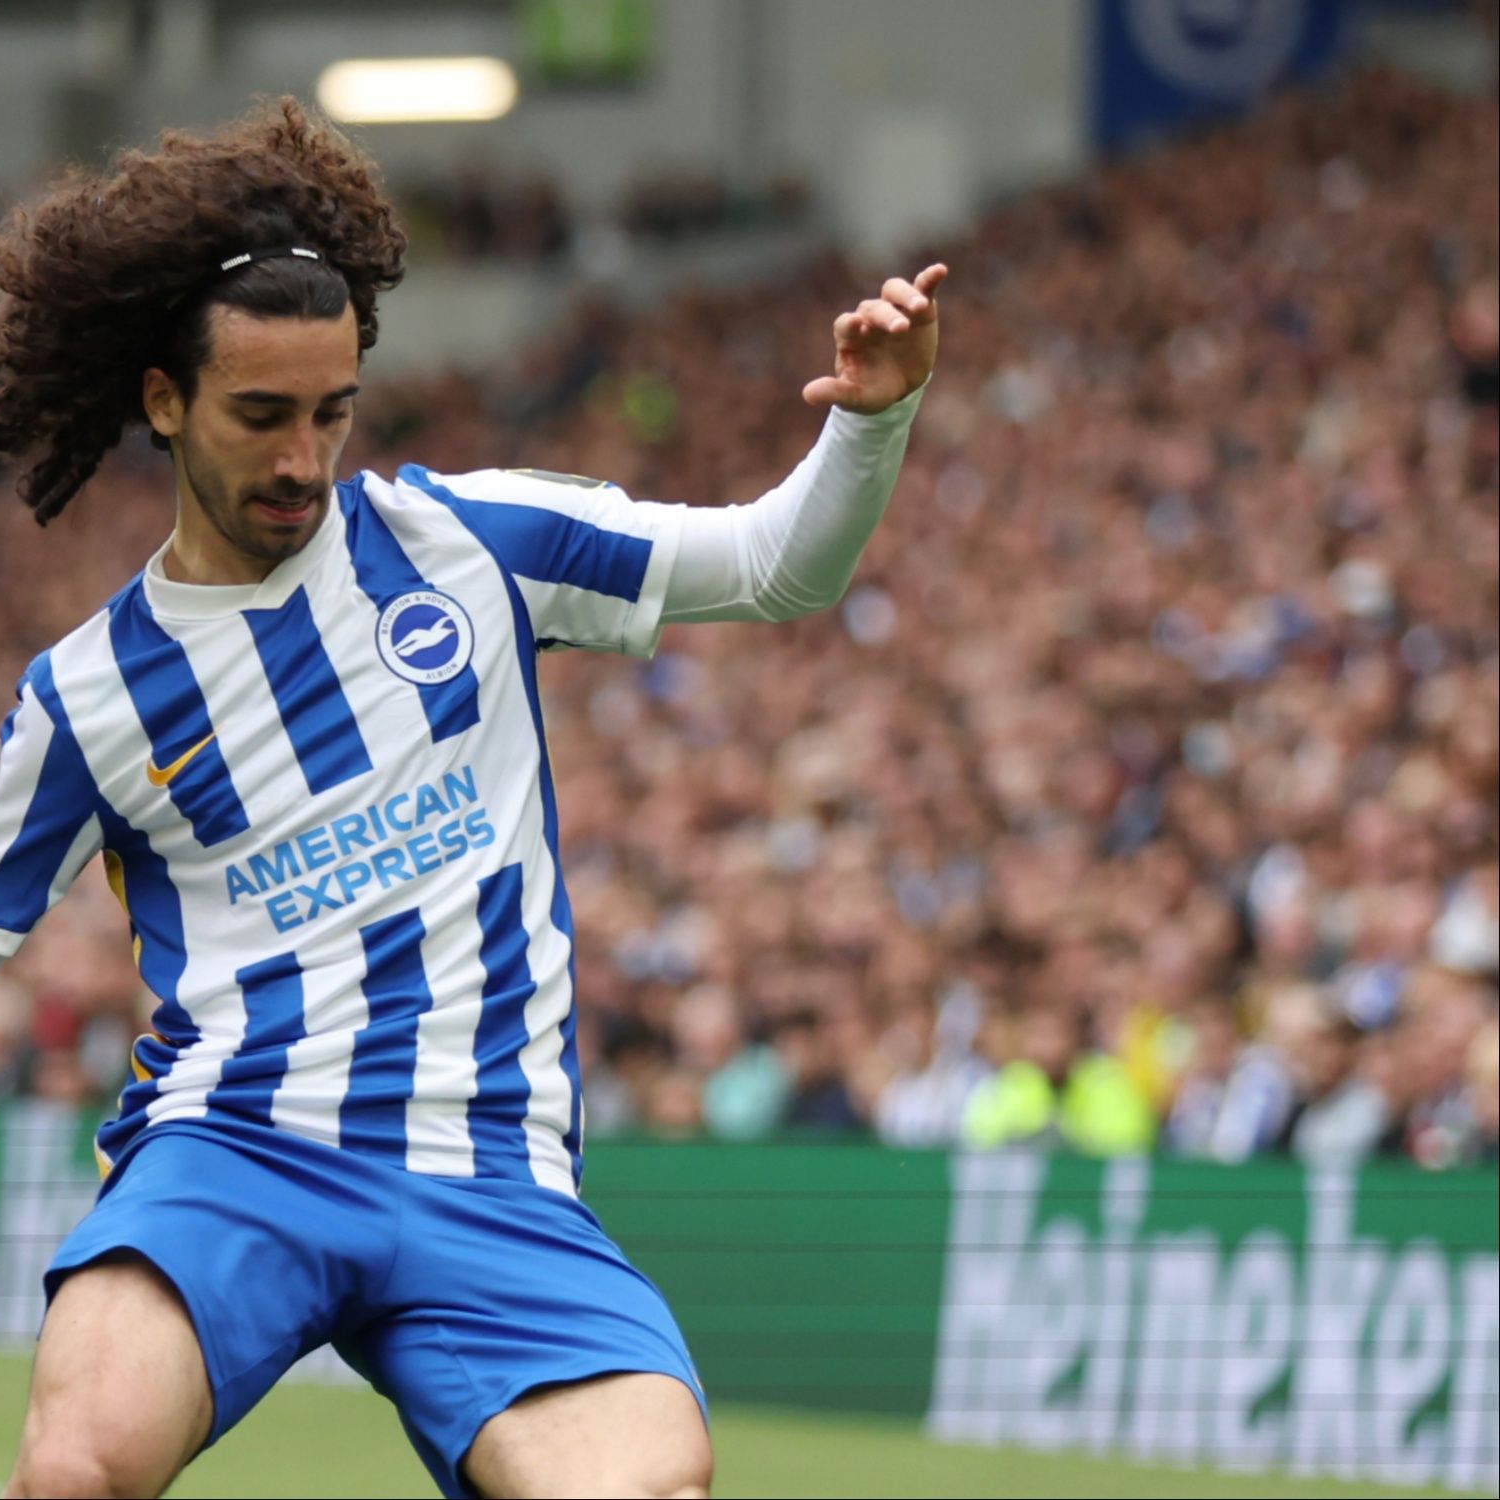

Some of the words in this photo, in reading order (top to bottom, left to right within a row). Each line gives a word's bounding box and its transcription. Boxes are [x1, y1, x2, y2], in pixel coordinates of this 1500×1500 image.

[381, 597, 411, 635] BRIGHTON
[425, 595, 449, 608] HOVE
[425, 663, 458, 680] ALBION
[225, 765, 479, 905] AMERICAN
[265, 808, 496, 934] EXPRESS
